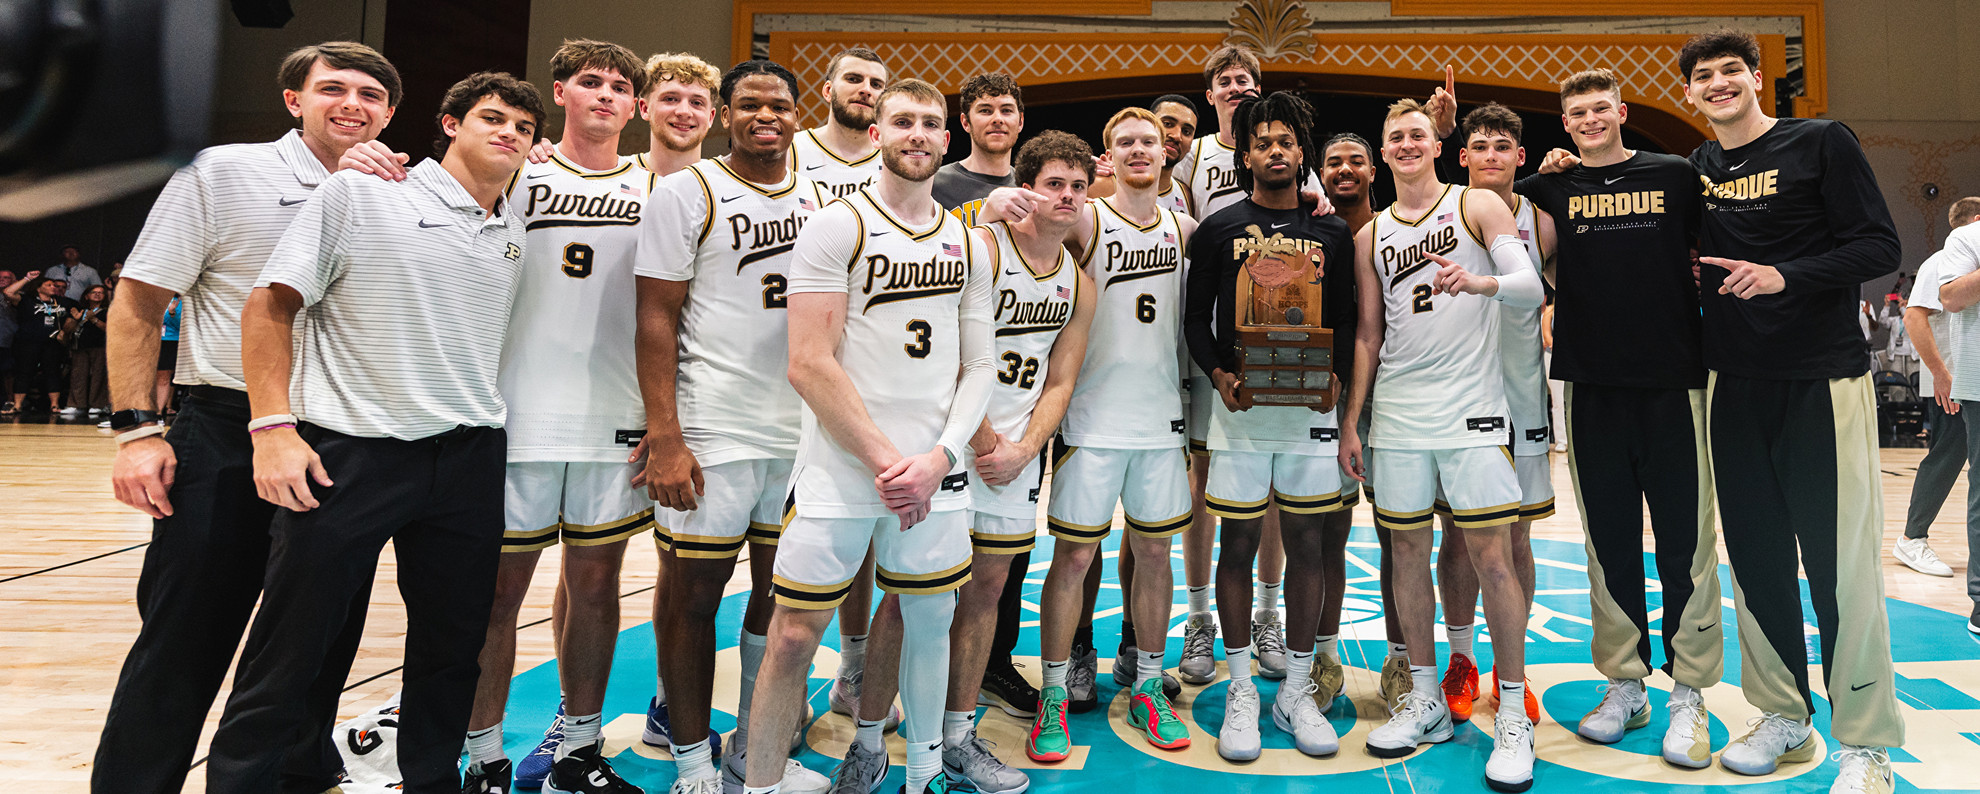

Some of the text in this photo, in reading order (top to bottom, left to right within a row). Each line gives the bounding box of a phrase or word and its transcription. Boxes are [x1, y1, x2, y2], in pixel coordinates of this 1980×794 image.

[1205, 166, 1238, 191] Pur
[525, 184, 642, 218] Purdue
[1568, 190, 1666, 220] PURDUE
[726, 210, 809, 251] Purd
[504, 242, 521, 262] P
[561, 241, 595, 280] 9
[1105, 240, 1178, 273] Purdue
[1380, 225, 1459, 277] Purdue
[862, 253, 966, 296] Purdue
[994, 288, 1069, 325] Purdue
[1135, 292, 1157, 324] 6
[1412, 283, 1433, 315] 2
[904, 318, 932, 360] 3
[996, 350, 1039, 391] 32
